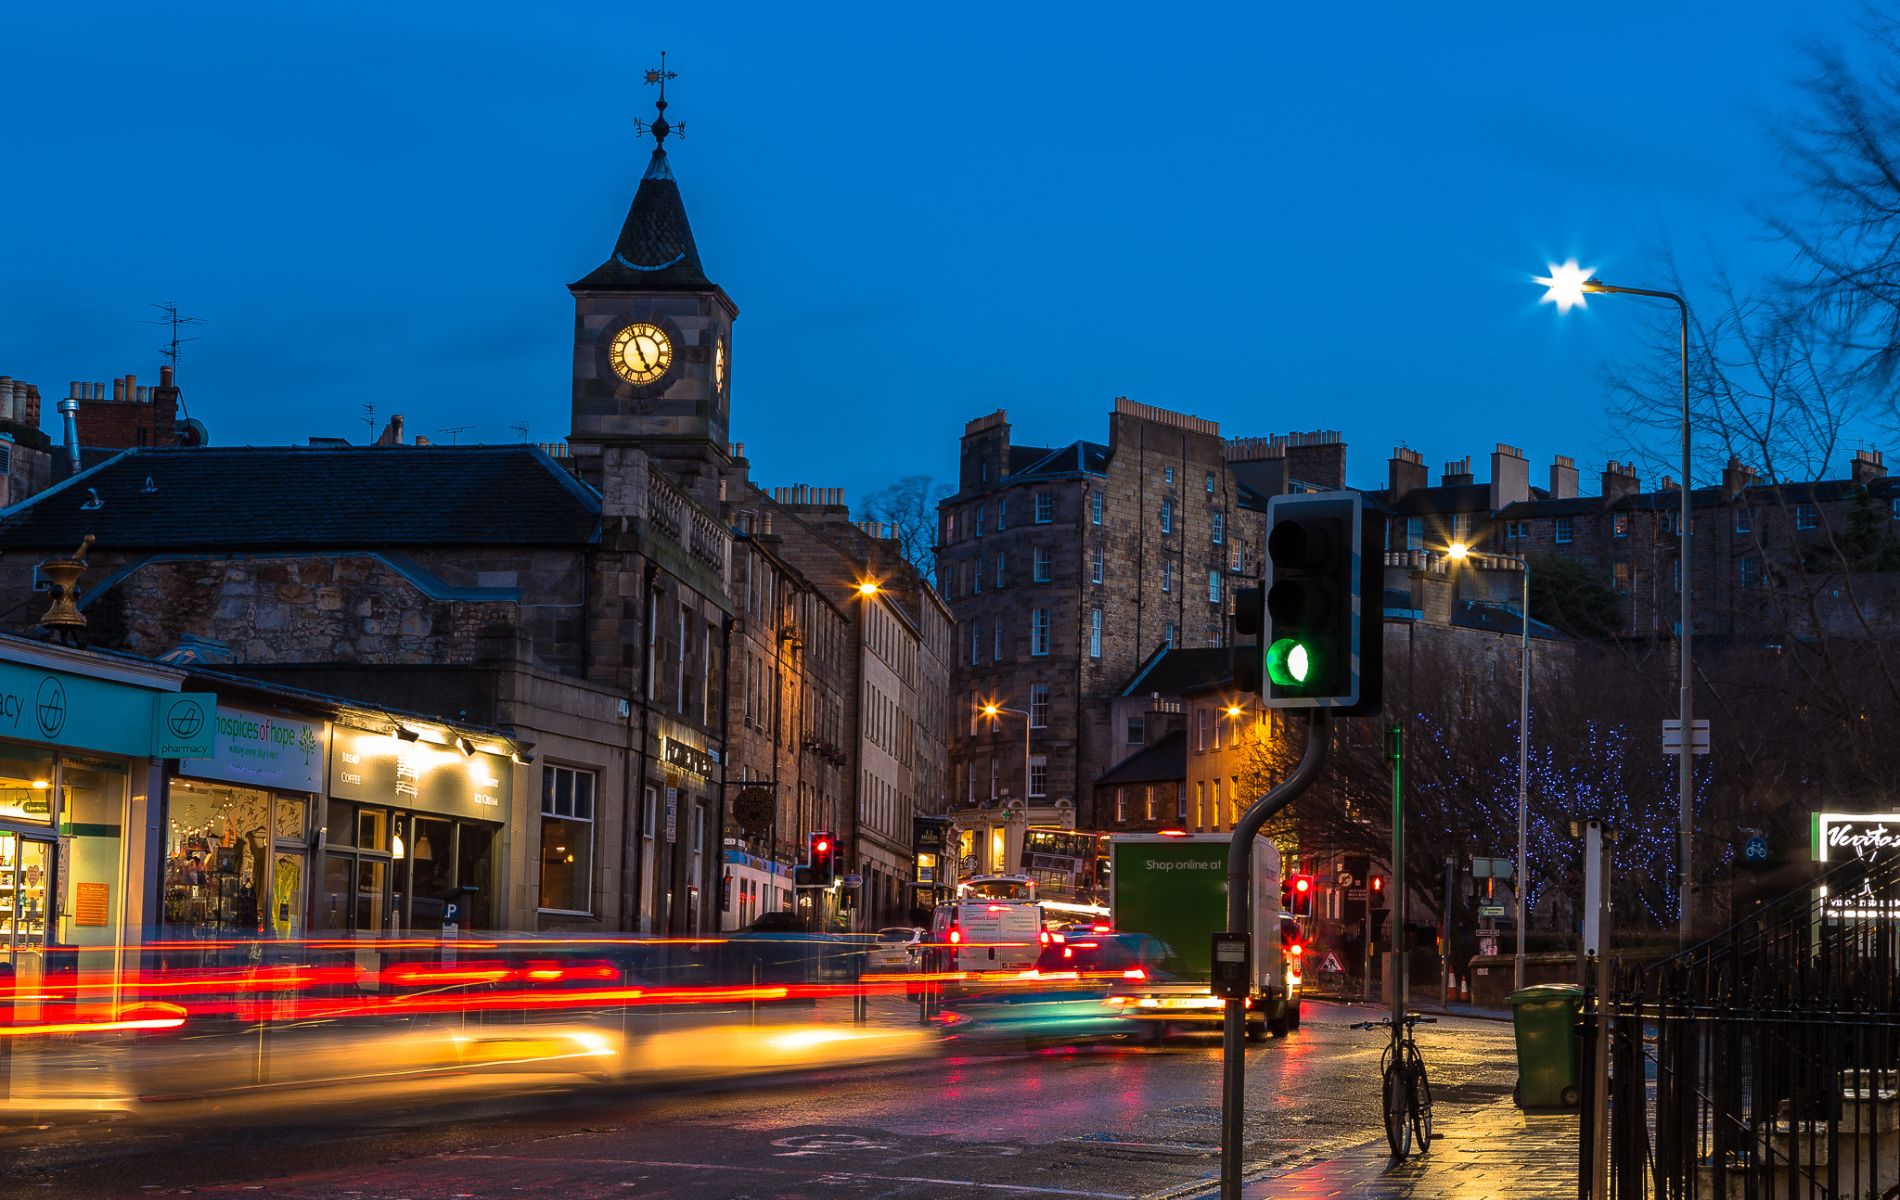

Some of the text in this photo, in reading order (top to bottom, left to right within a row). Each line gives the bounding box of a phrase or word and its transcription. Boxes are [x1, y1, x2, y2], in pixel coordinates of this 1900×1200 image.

[260, 718, 271, 741] of
[271, 720, 295, 750] hope
[161, 743, 208, 756] pharmacy
[340, 771, 361, 785] COFFEE
[1146, 859, 1222, 873] Shop online at
[447, 903, 457, 918] P
